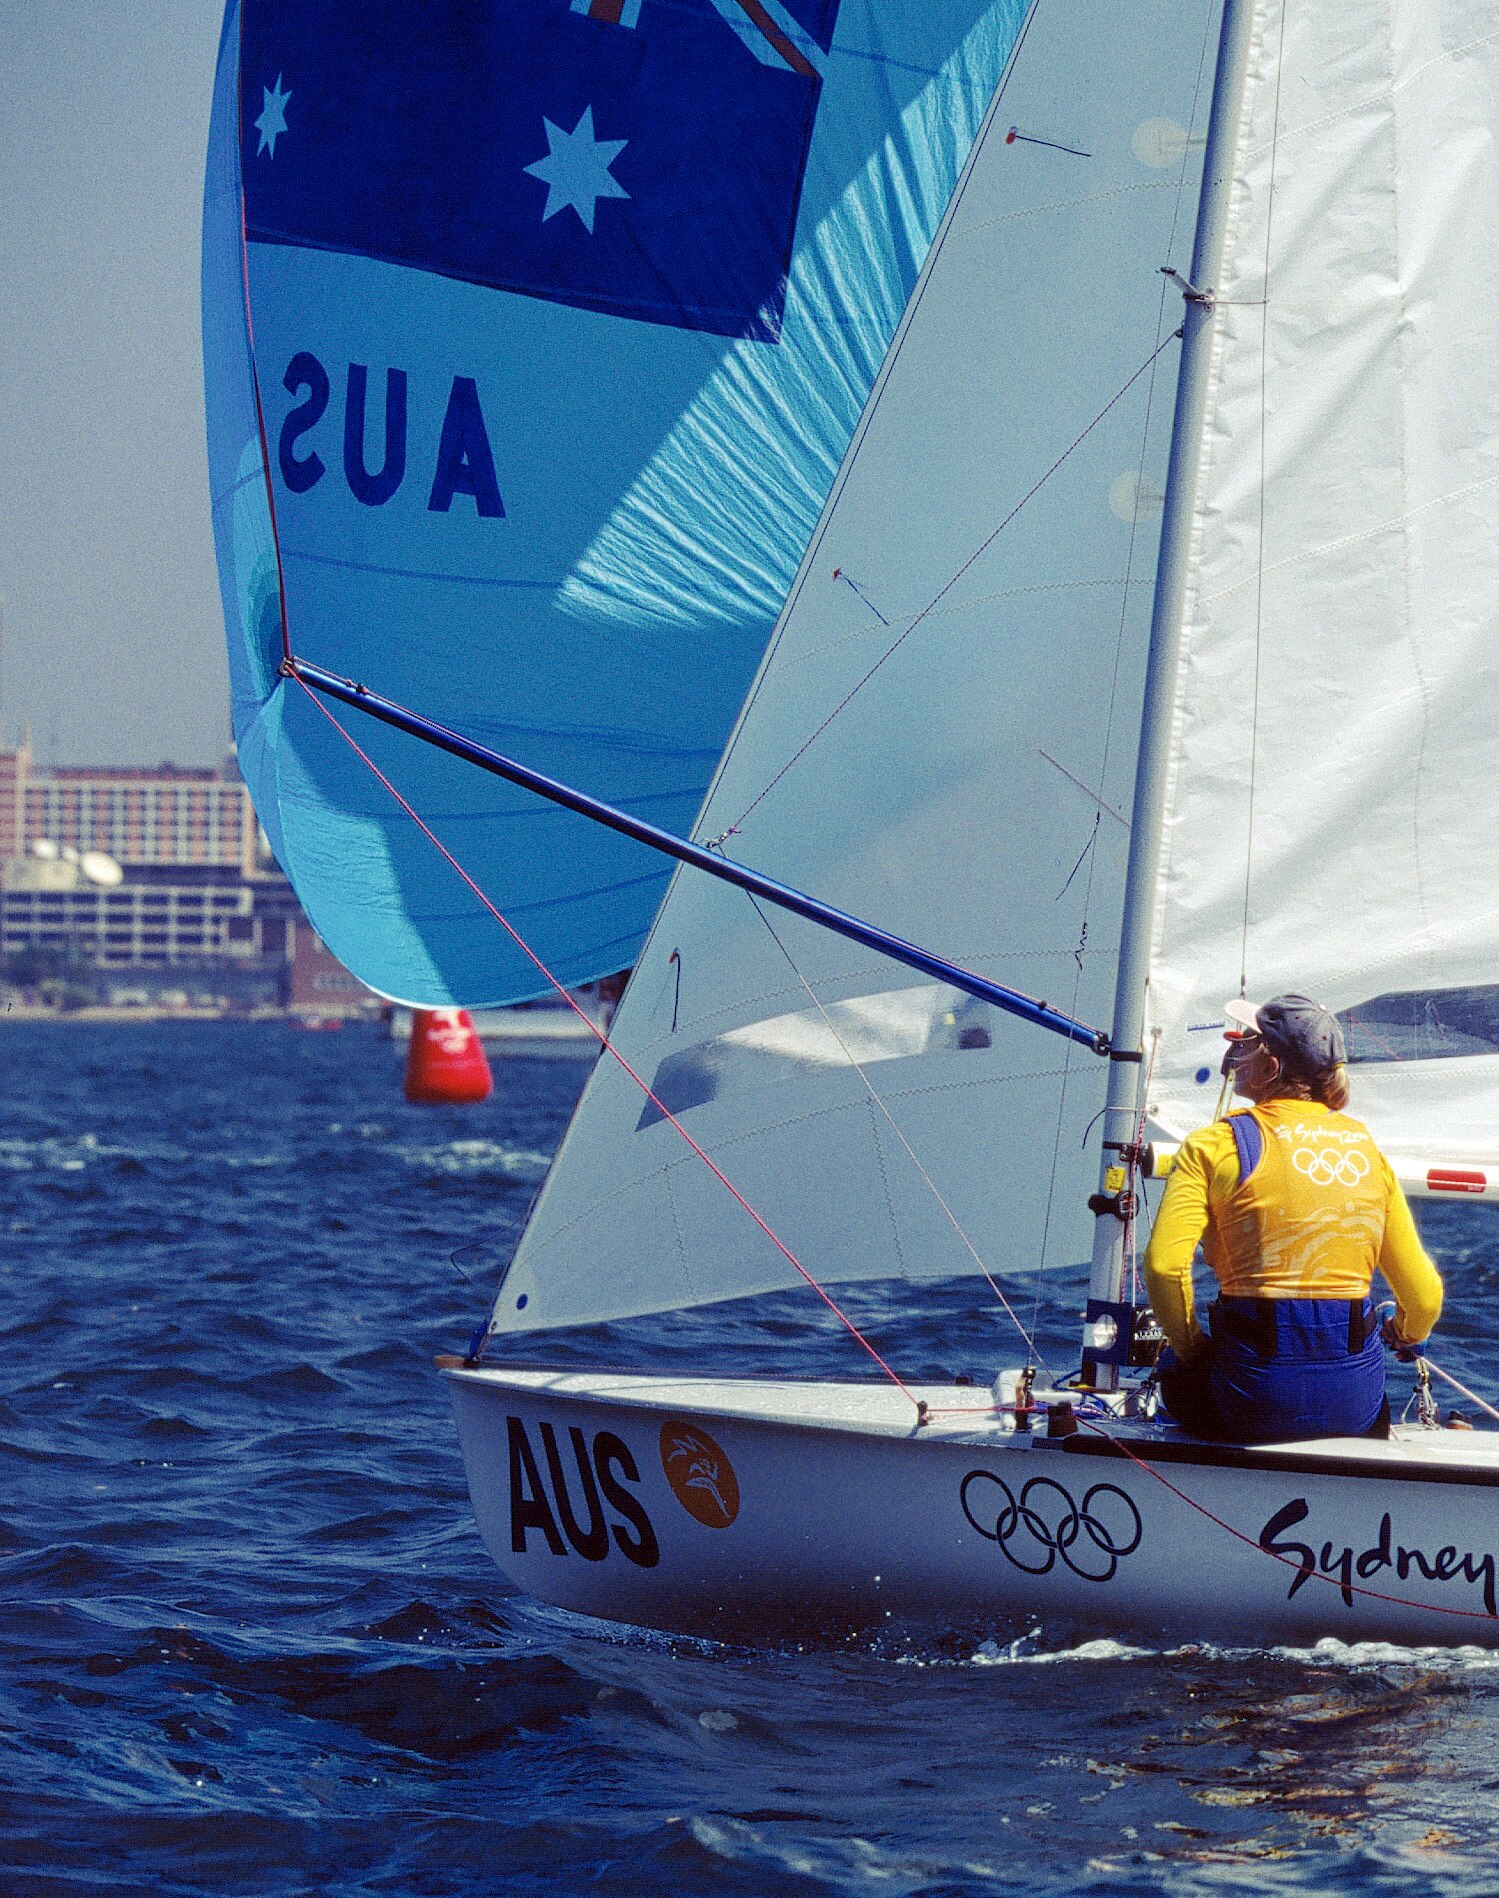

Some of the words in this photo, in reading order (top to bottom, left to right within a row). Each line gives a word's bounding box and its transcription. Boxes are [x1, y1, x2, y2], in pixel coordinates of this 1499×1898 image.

[1294, 1123, 1343, 1145] Sydney
[507, 1415, 660, 1568] AUS
[1259, 1498, 1497, 1617] Sydney
